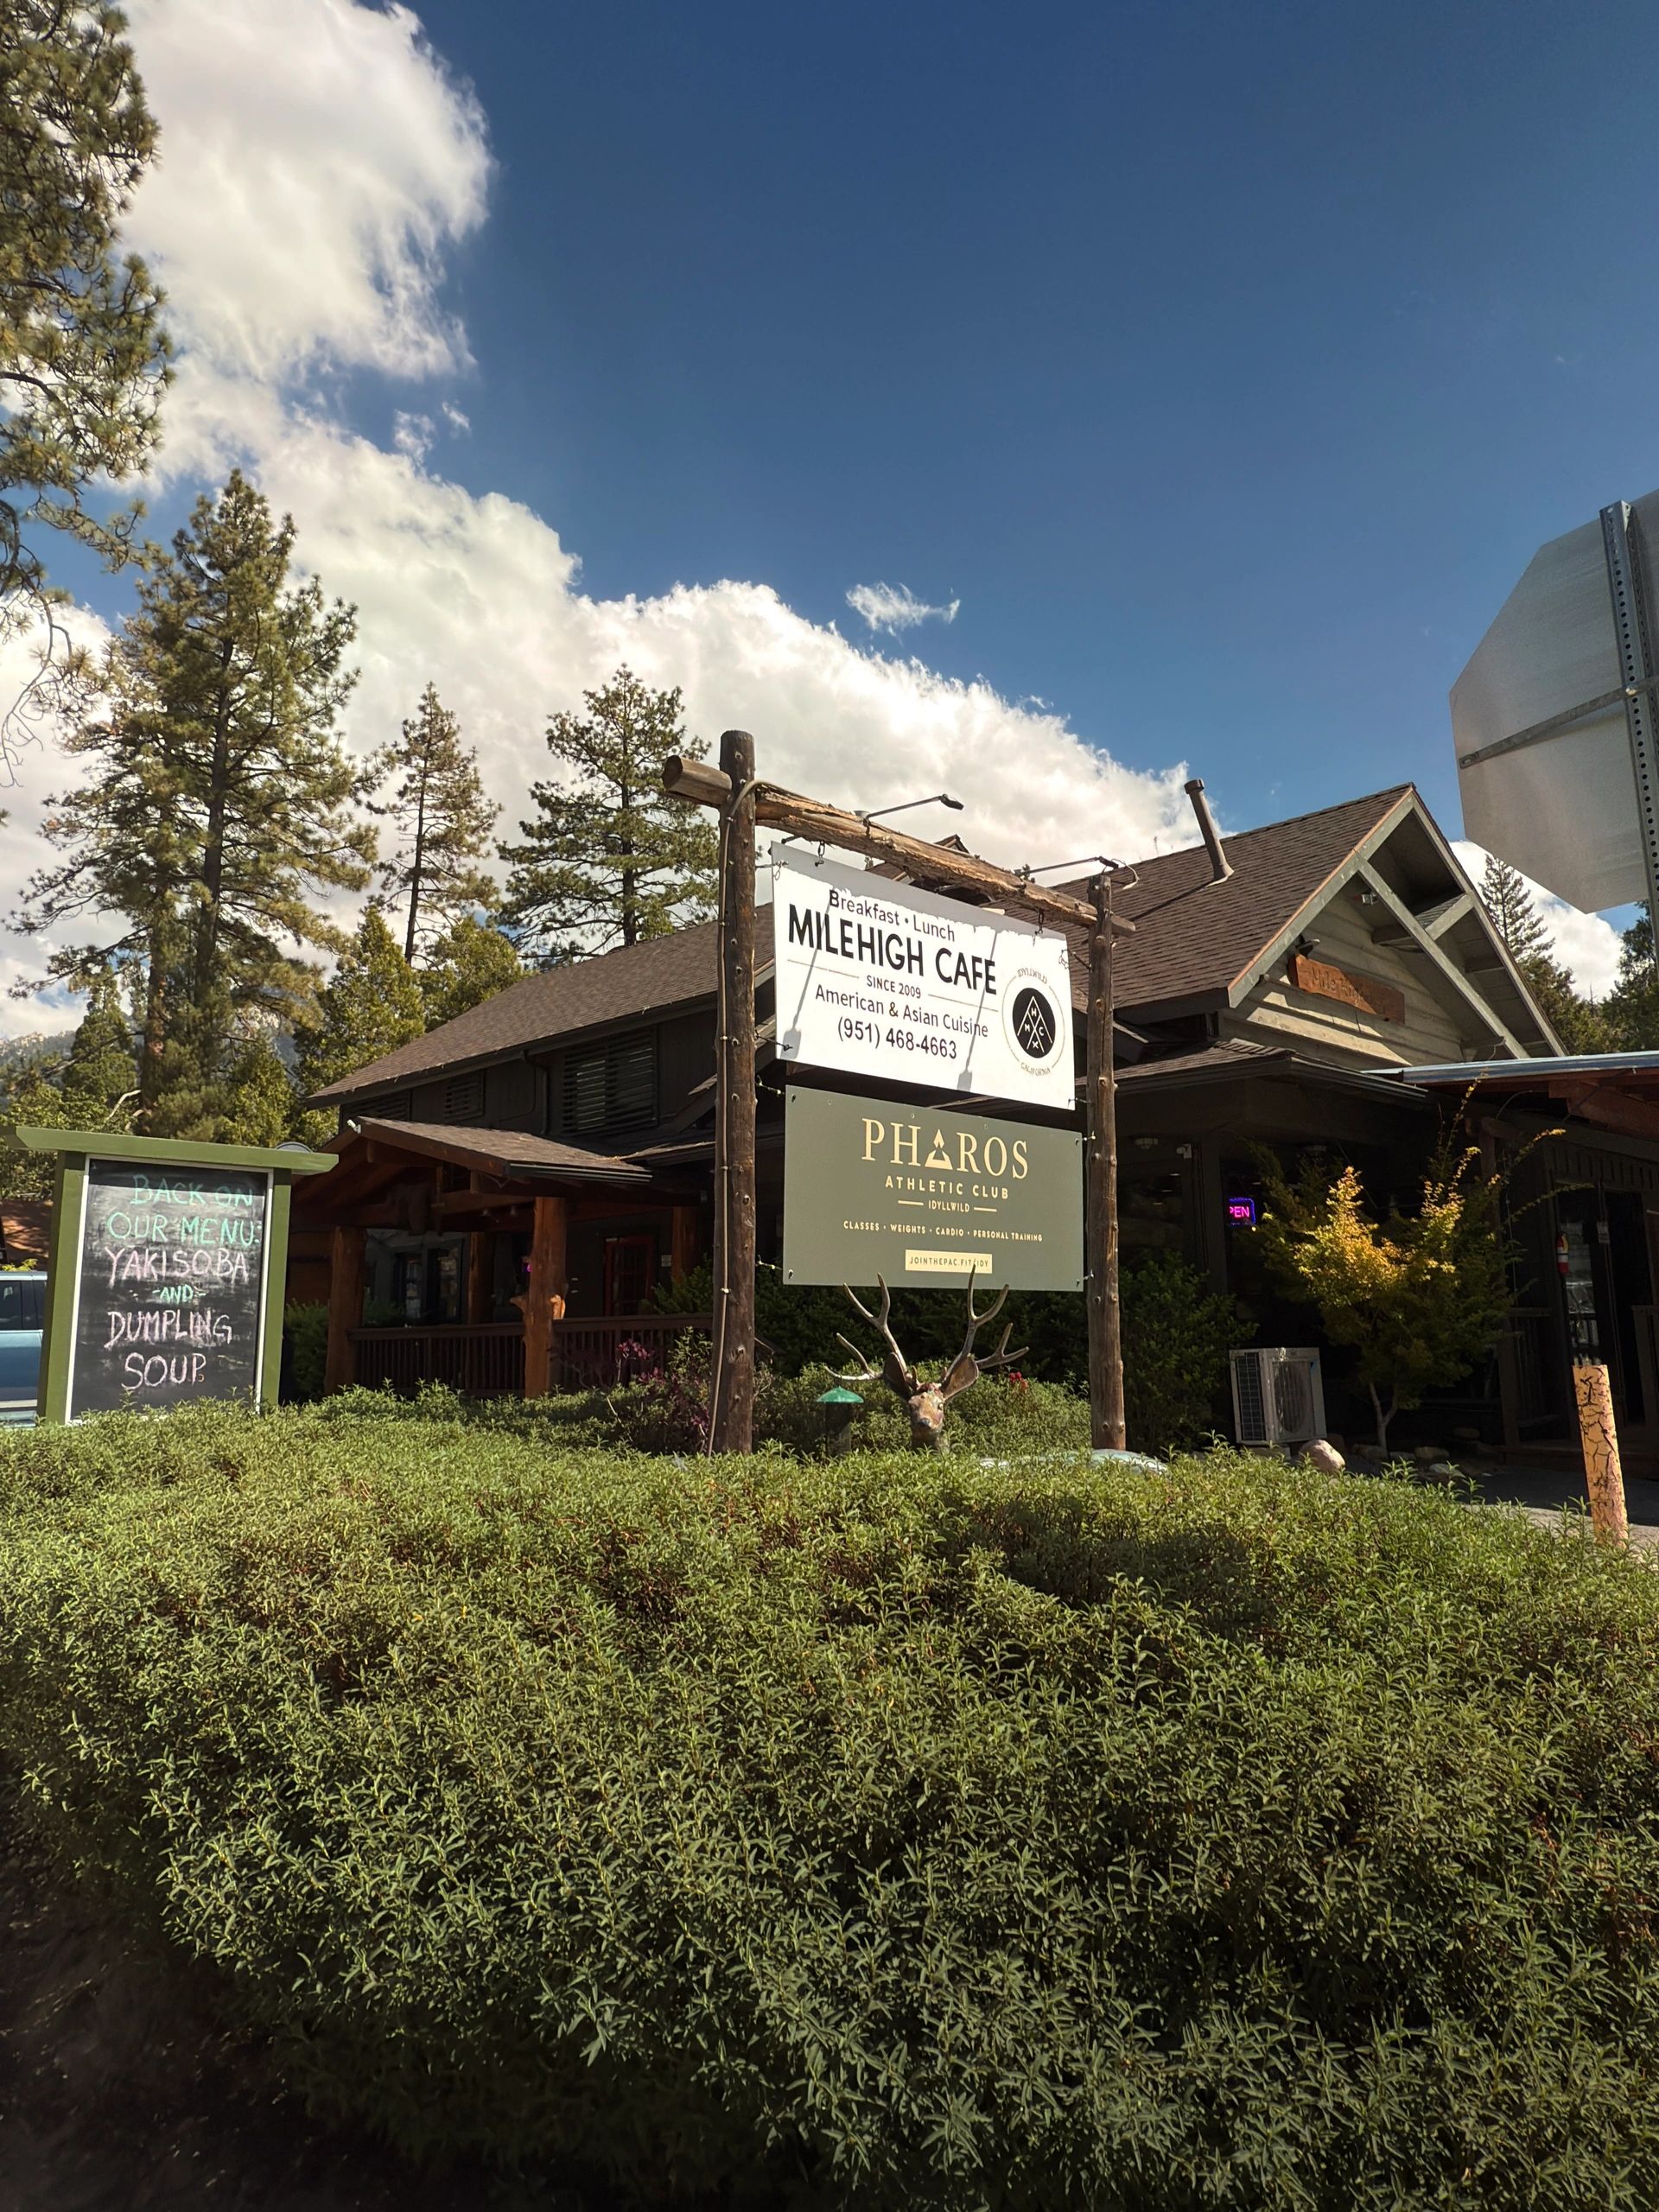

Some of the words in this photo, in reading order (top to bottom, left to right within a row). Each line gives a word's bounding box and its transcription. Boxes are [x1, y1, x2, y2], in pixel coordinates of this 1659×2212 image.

[830, 889, 900, 925] Breakfast
[912, 915, 955, 942] Lunch
[788, 904, 924, 976] MILEHIGH
[935, 948, 997, 995] CAFE
[867, 975, 896, 993] SINCE
[898, 982, 921, 999] 2009
[816, 984, 884, 1014] American
[888, 1001, 899, 1017] &
[903, 1005, 938, 1027] Asian
[943, 1014, 988, 1038] Cuisine
[837, 1016, 880, 1048] (951)
[886, 1027, 957, 1059] 468-4663
[861, 1117, 1029, 1179] PHAROS
[130, 1174, 207, 1205] BACK
[214, 1185, 254, 1207] ON
[885, 1176, 963, 1195] ATHLETIC
[972, 1185, 1009, 1199] CLUB
[928, 1199, 970, 1213] IDYLLWILD
[105, 1211, 168, 1243] OUR
[1229, 1205, 1250, 1218] PEN
[843, 1220, 880, 1231] CLASSES
[890, 1224, 926, 1235] WEIGHTS
[935, 1227, 964, 1237] CARDIO
[973, 1230, 1009, 1240] PERSONAL
[1011, 1232, 1043, 1242] TRAINING
[105, 1247, 250, 1288] YAKISOBA
[104, 1309, 232, 1350] DUMPLING
